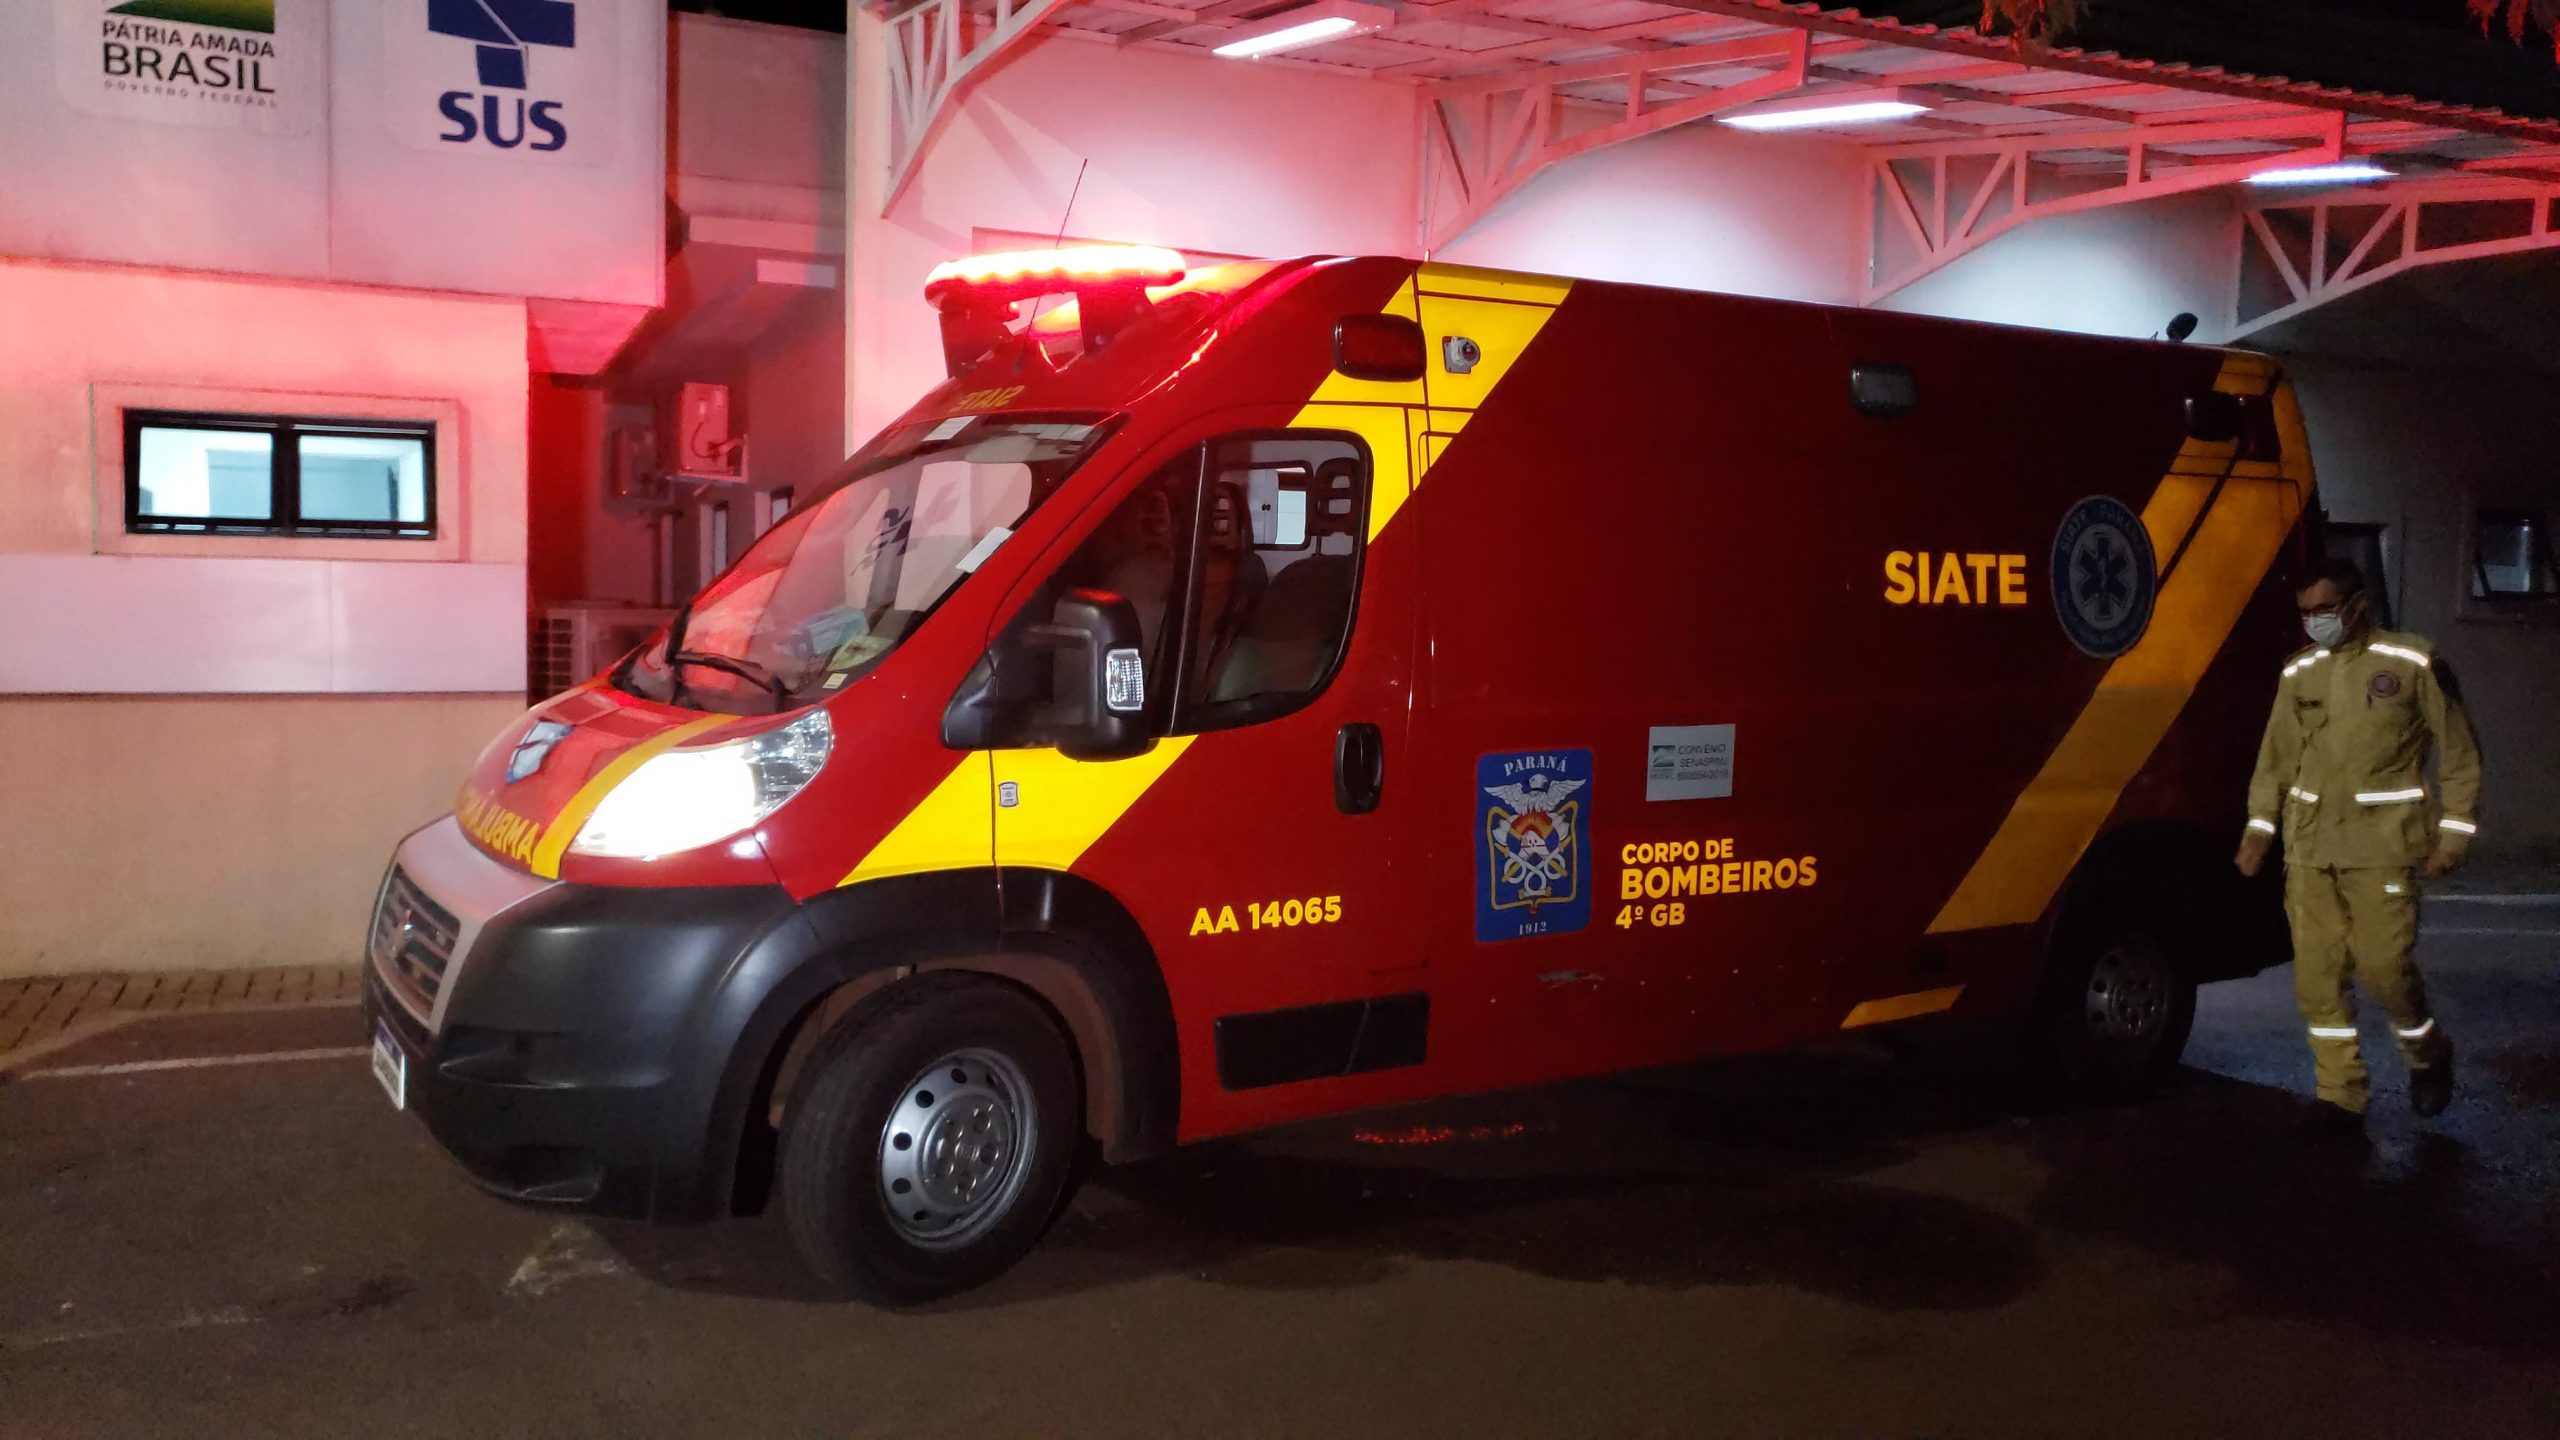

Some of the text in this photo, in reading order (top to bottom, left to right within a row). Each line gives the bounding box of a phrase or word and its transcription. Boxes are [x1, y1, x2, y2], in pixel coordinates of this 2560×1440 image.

[102, 18, 275, 58] PÁTRIA AMADA
[103, 42, 275, 94] BRASIL
[104, 80, 277, 109] GOVERNO FEDERAL
[438, 91, 567, 151] SUS
[1884, 550, 2027, 604] SIATE
[1504, 755, 1567, 777] PARANÁ
[1622, 838, 1734, 865] CORPO DE
[1621, 856, 1817, 900] BOMBEIROS
[1189, 895, 1342, 936] AA 14065
[1518, 920, 1547, 935] 1912
[1615, 902, 1685, 929] 4º GB
